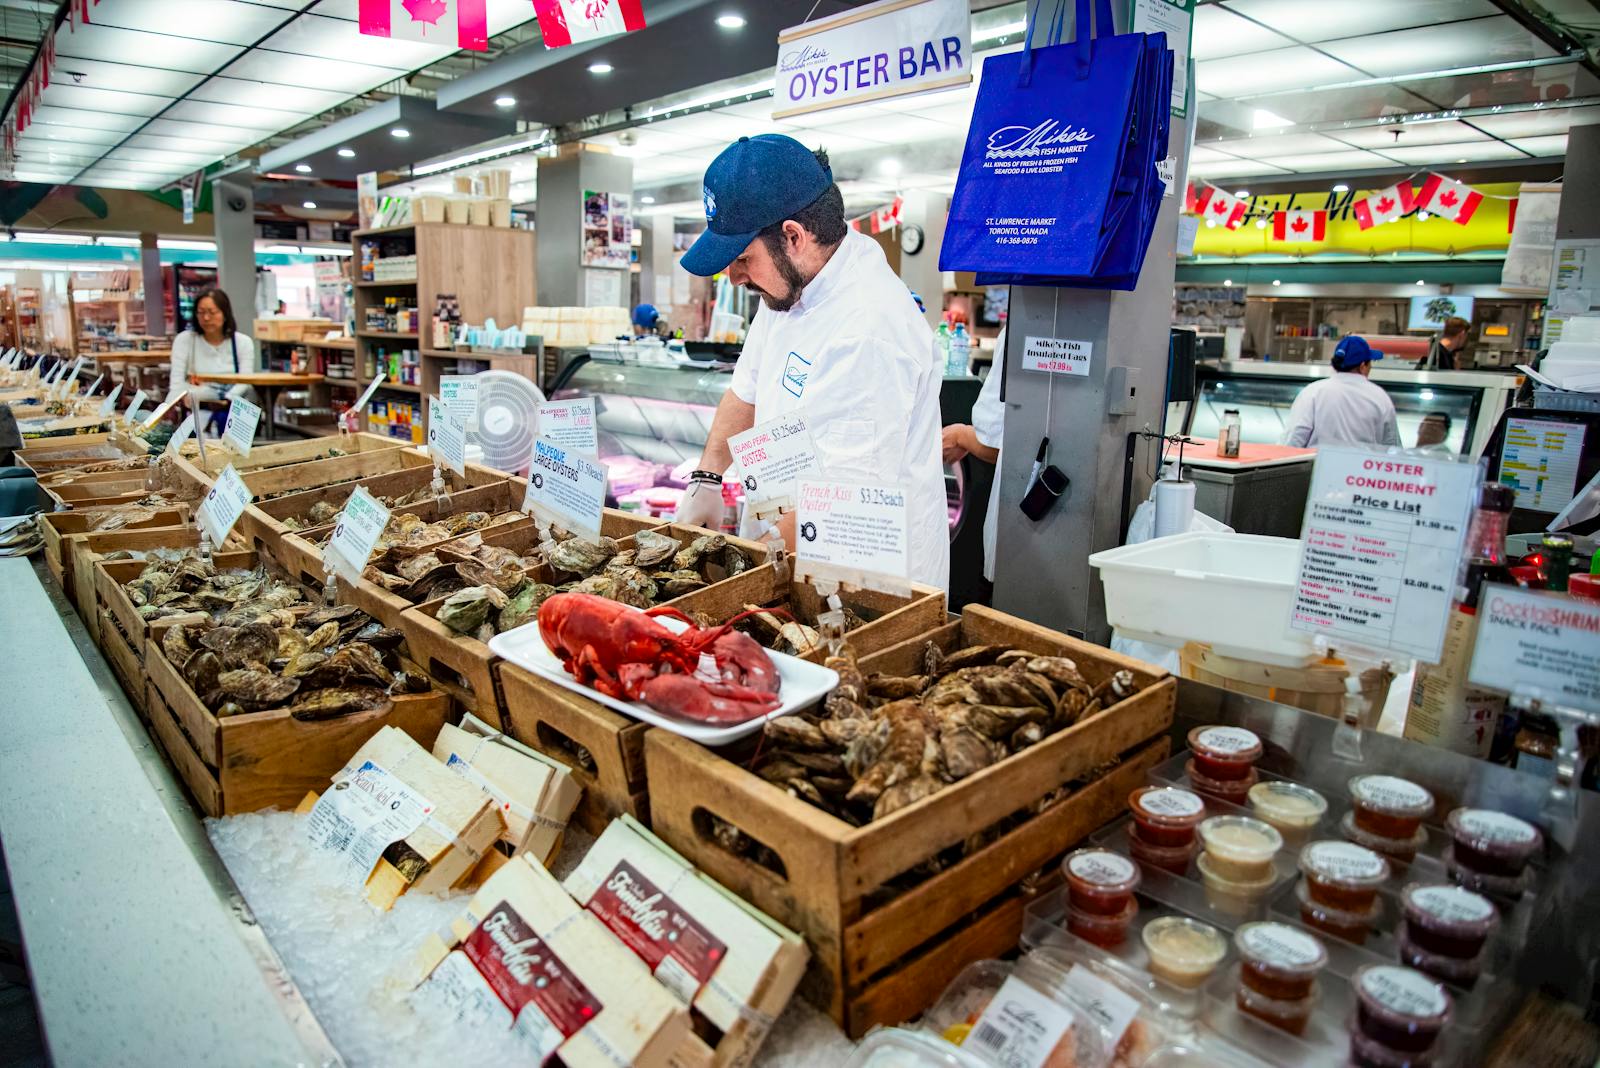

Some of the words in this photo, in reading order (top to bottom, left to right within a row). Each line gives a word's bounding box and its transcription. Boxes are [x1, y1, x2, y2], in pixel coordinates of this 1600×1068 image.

[789, 53, 889, 101] OYSTER
[898, 36, 964, 79] BAR
[1018, 118, 1095, 150] Mike's
[1058, 145, 1088, 154] MARKET
[995, 217, 1029, 225] LAWRENCE
[1030, 217, 1057, 226] MARKET
[1020, 227, 1049, 235] CANADA
[1027, 349, 1066, 360] Insulated
[1036, 340, 1062, 348] Mike's
[1063, 342, 1081, 350] Fish
[536, 440, 566, 464] MALPEQUE
[733, 440, 753, 455] ISLAND
[752, 433, 772, 448] PEARL
[534, 452, 552, 470] LARGE
[552, 460, 579, 482] OYSTERS
[741, 447, 768, 467] OYSTERS
[1363, 459, 1424, 476] OYSTER
[802, 483, 831, 498] French
[832, 485, 852, 502] Kiss
[1345, 475, 1437, 496] CONDIMENT
[1352, 493, 1389, 509] Price
[1394, 500, 1421, 514] List
[1489, 615, 1526, 630] SNACK
[1530, 623, 1560, 636] PACK
